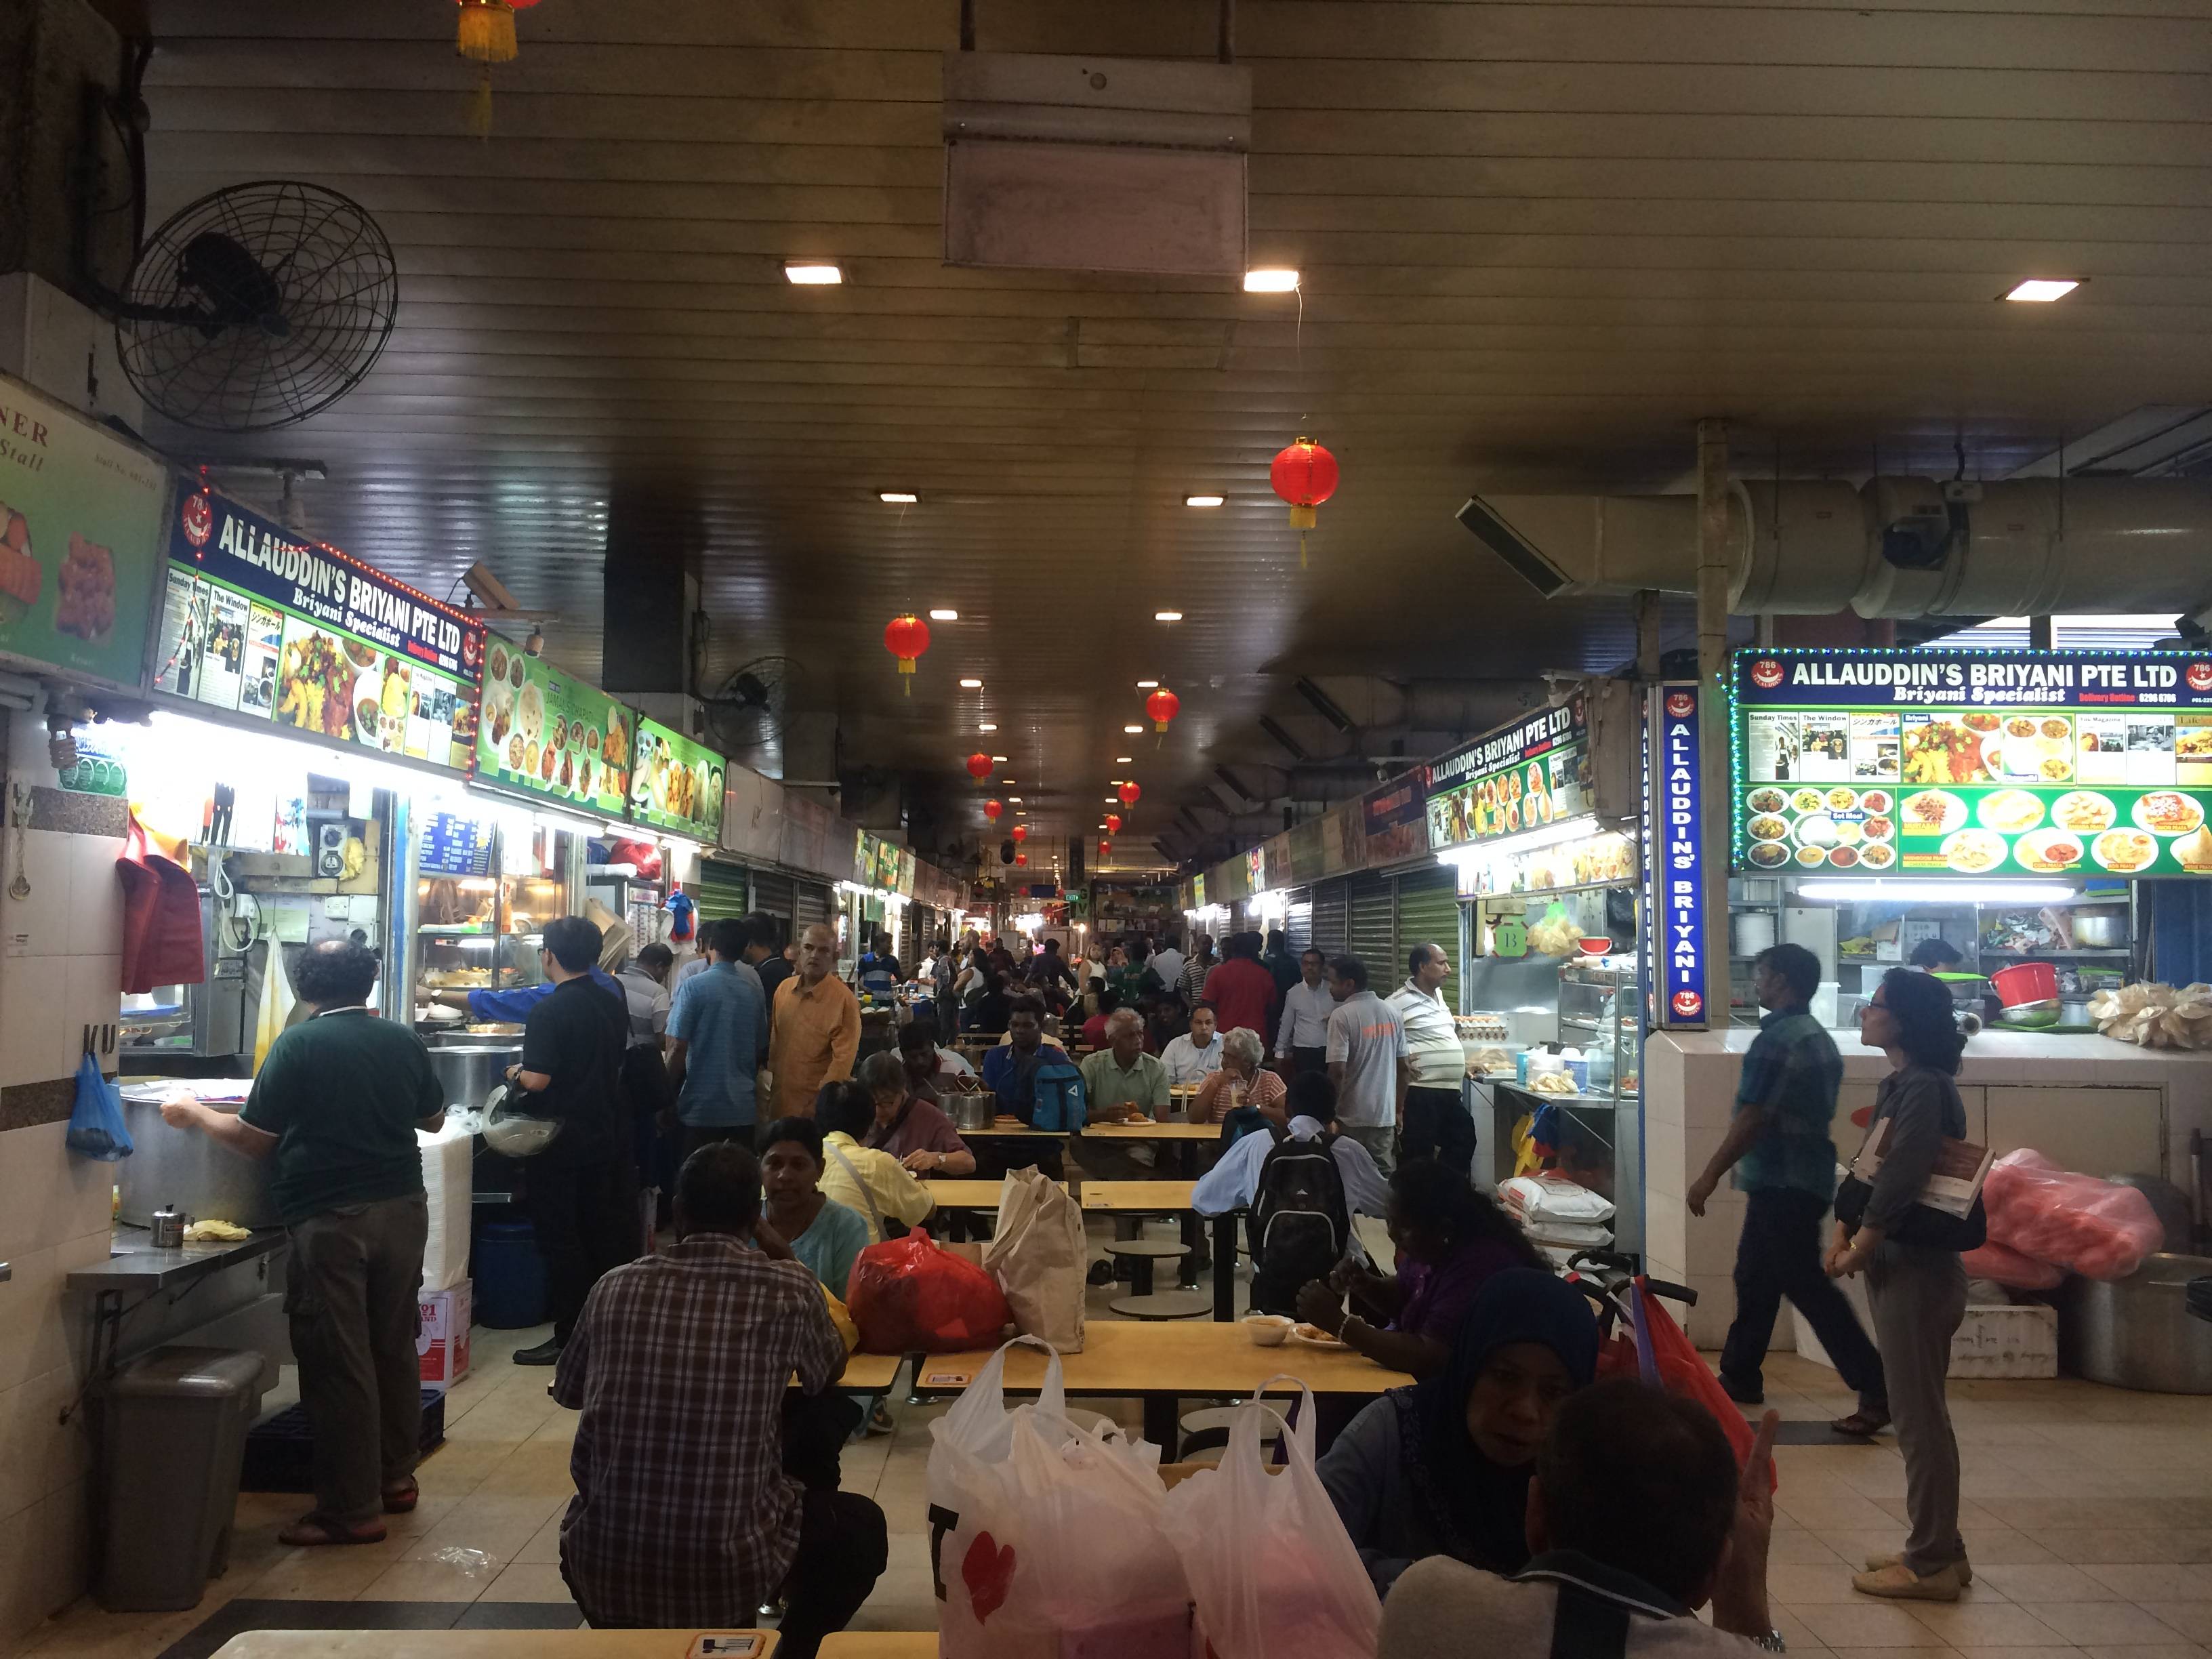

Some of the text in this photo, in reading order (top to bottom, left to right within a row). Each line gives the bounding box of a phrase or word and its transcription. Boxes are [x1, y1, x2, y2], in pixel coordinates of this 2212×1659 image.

[0, 438, 43, 472] Stall
[169, 573, 191, 590] Sunday
[218, 514, 346, 603] ALLAUDDIN'S
[349, 575, 411, 634] BRIYANI
[411, 606, 438, 645] PTE
[438, 619, 461, 655] LTD
[213, 590, 248, 611] The Window
[293, 588, 401, 647] Briyani Specialist
[1759, 661, 1776, 669] 786
[1792, 663, 2177, 687] ALLAUDDIN'S BRIYANI PTE LTD
[2194, 664, 2211, 672] 786
[1893, 686, 2066, 705] Briyani Specialist
[1432, 746, 1483, 784] ALLAUDDIN'S
[1484, 727, 1524, 762] BRIYANI
[1525, 716, 1547, 745] PTE
[1549, 707, 1571, 735] LTD
[1465, 751, 1520, 781] Briyani Specialist
[1505, 933, 1517, 948] 13
[1673, 880, 1696, 983] BRIYANI
